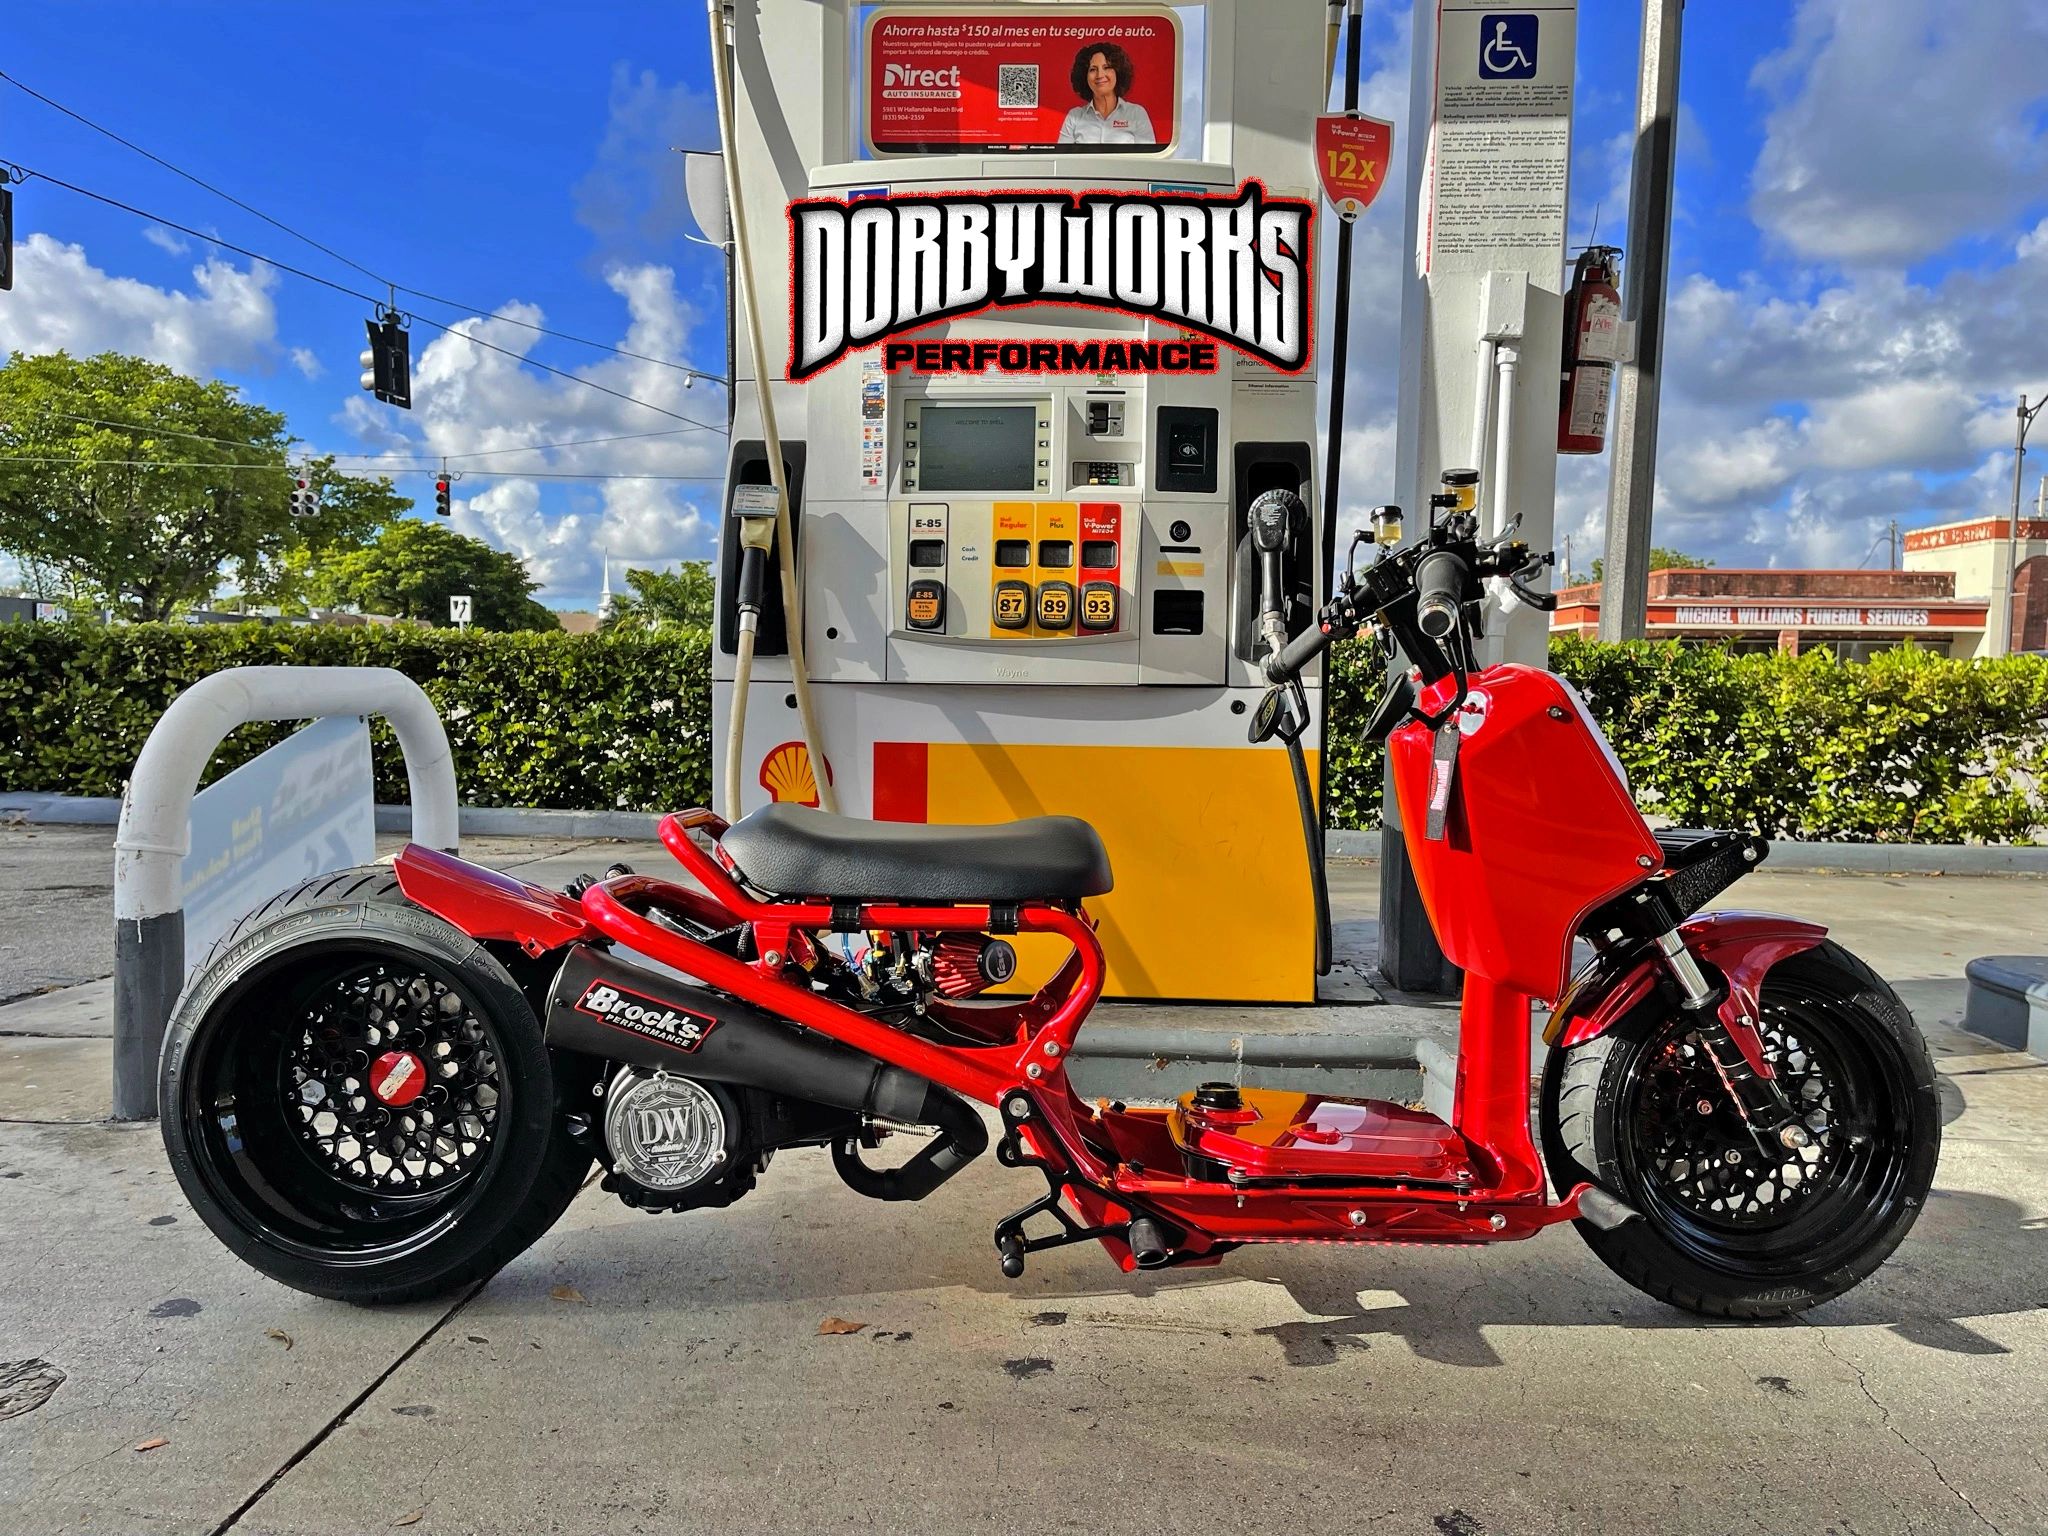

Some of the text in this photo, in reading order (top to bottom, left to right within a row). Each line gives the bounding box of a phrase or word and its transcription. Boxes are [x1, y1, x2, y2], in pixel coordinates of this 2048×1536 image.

[883, 24, 1155, 39] Ahorra hasta $150 al mes en tu seguro de auto.
[884, 63, 960, 87] Direct
[915, 519, 942, 528] E-85
[1000, 599, 1022, 612] 87
[1044, 600, 1066, 613] 89
[1088, 600, 1110, 613] 93
[1675, 606, 1928, 626] MICHAEL WILLIAMS FUNERAL SERVICES
[995, 667, 1029, 679] Wayne
[202, 931, 266, 995] MICHELIN
[586, 986, 699, 1039] Brock's
[605, 1014, 690, 1047] PERFORMANCE
[633, 1082, 692, 1100] DORBYWORKS
[637, 1107, 691, 1145] DW
